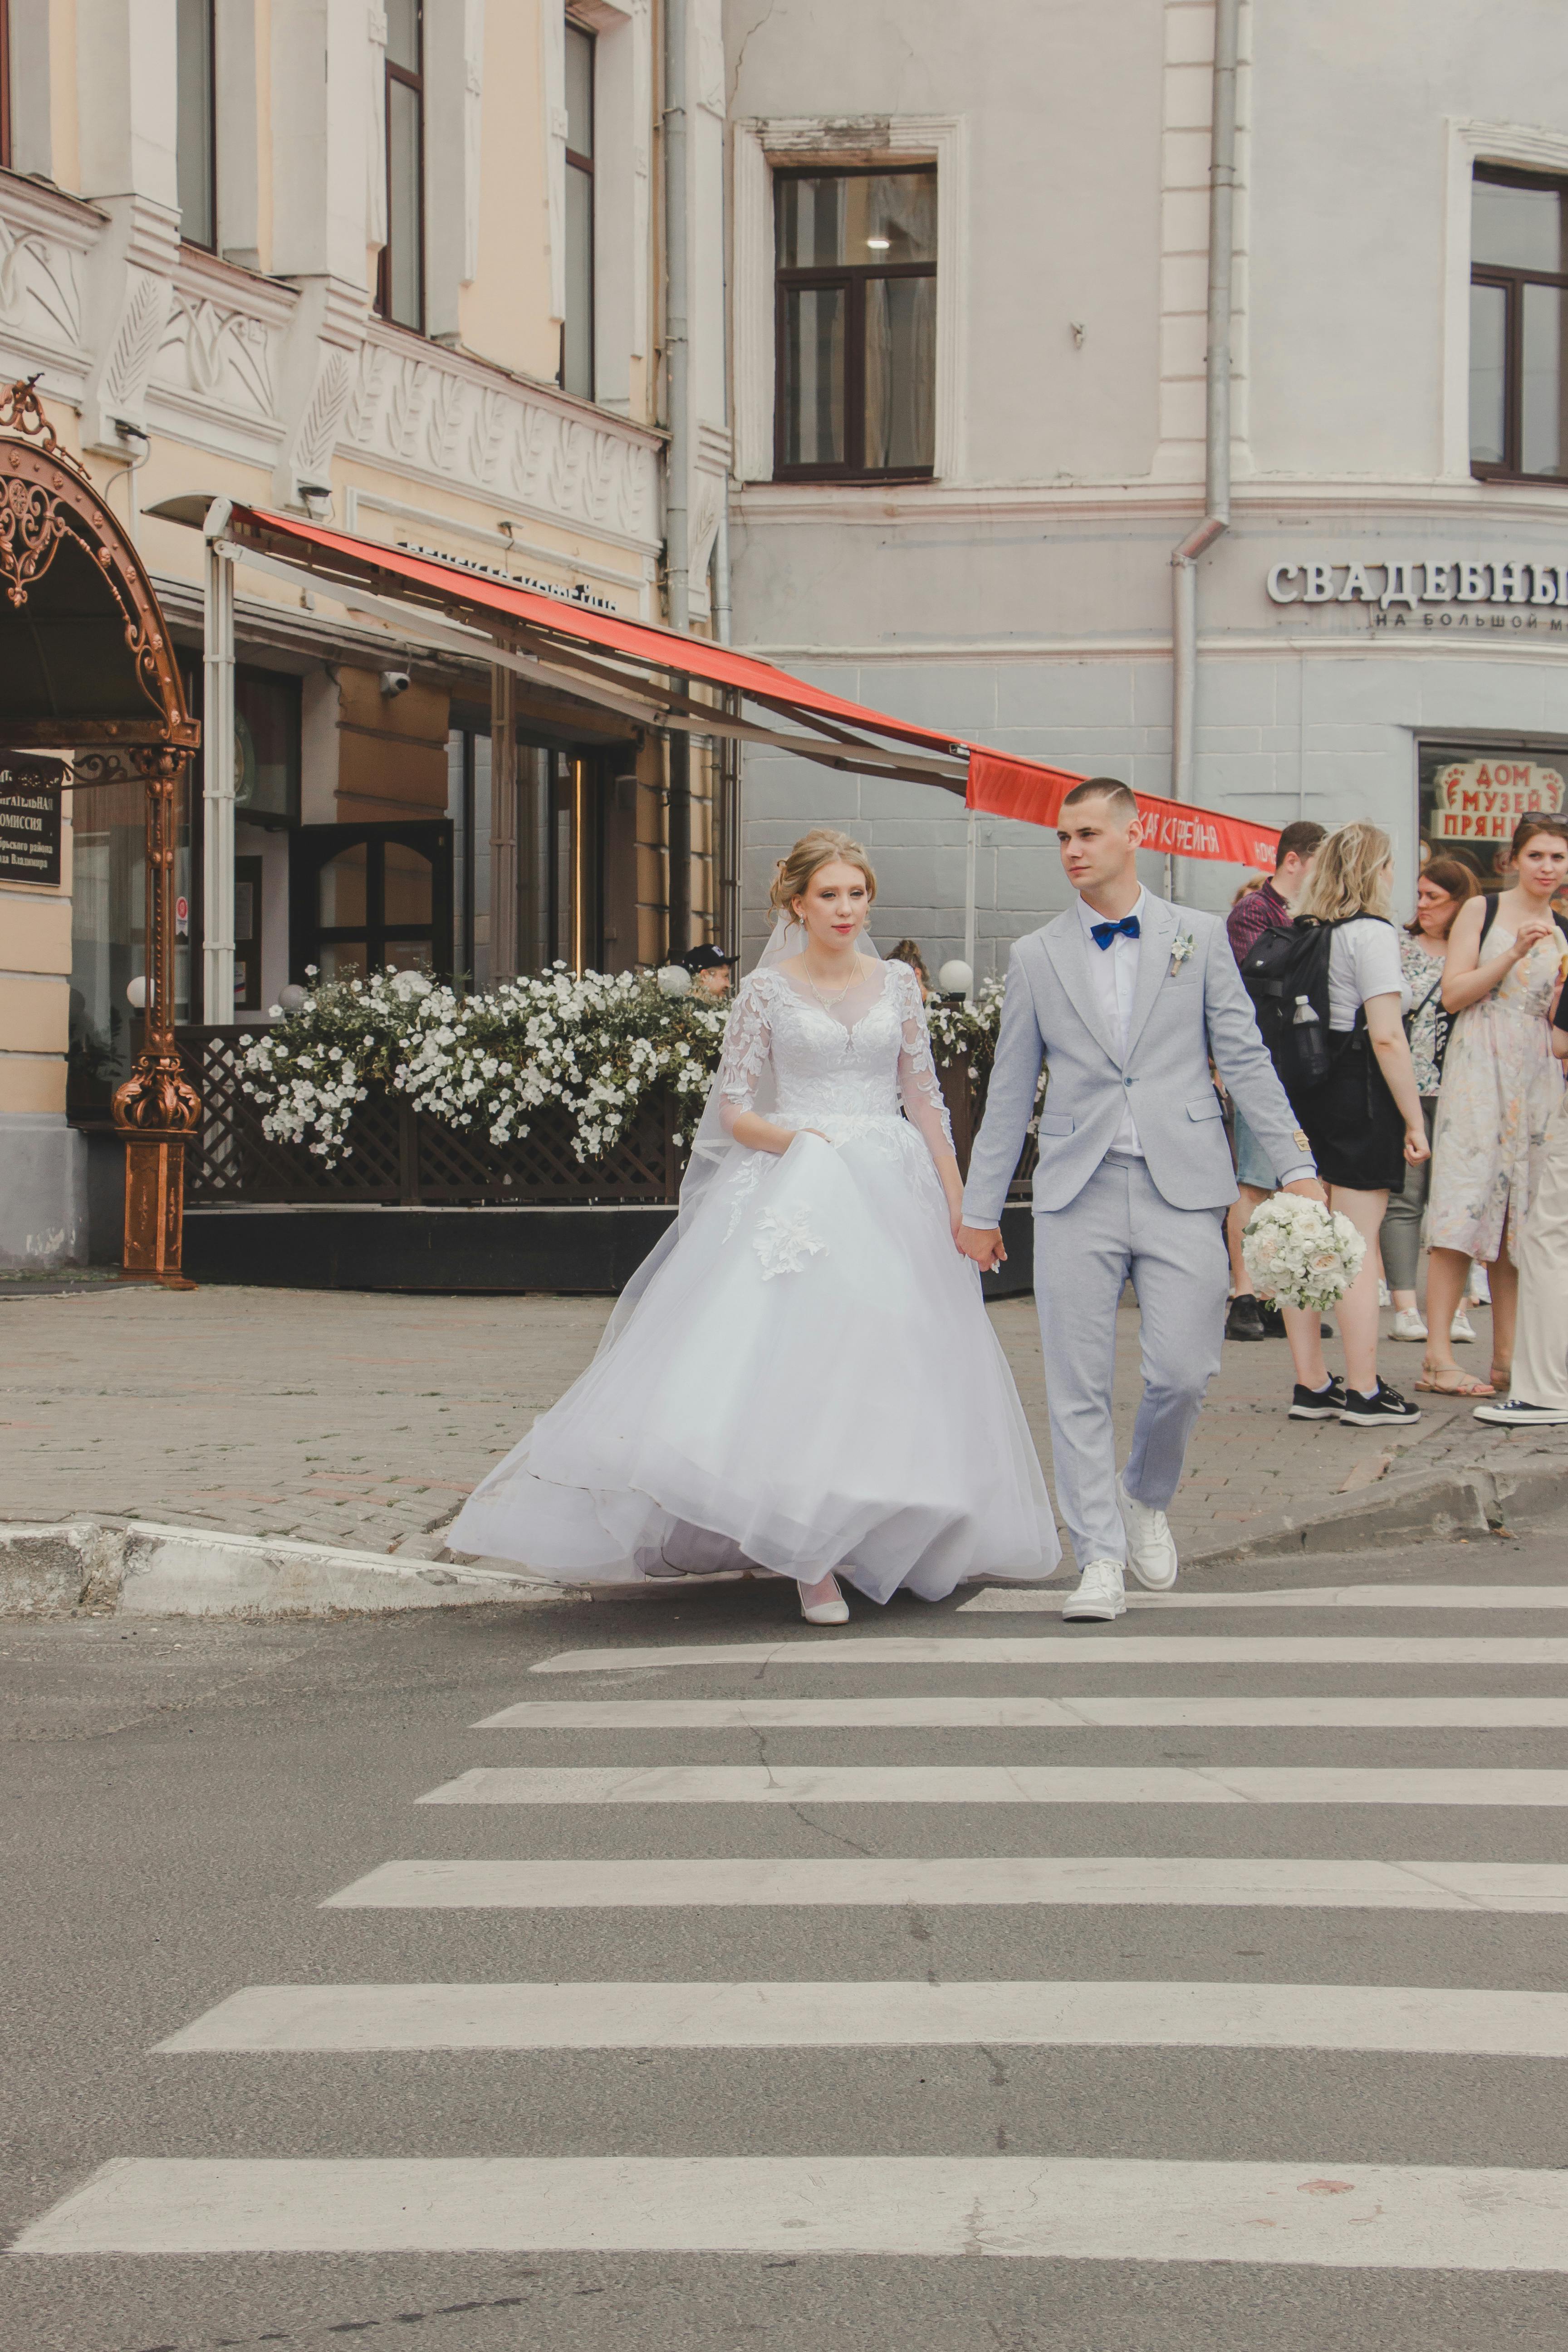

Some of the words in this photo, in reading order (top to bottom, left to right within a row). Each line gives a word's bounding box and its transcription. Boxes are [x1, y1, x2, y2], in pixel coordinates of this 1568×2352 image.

[1376, 613, 1406, 627] НА
[1424, 612, 1538, 629] БОЛЬШОЙ
[1476, 764, 1531, 789] ДОМ
[1462, 789, 1541, 813] МУЗЕЙ
